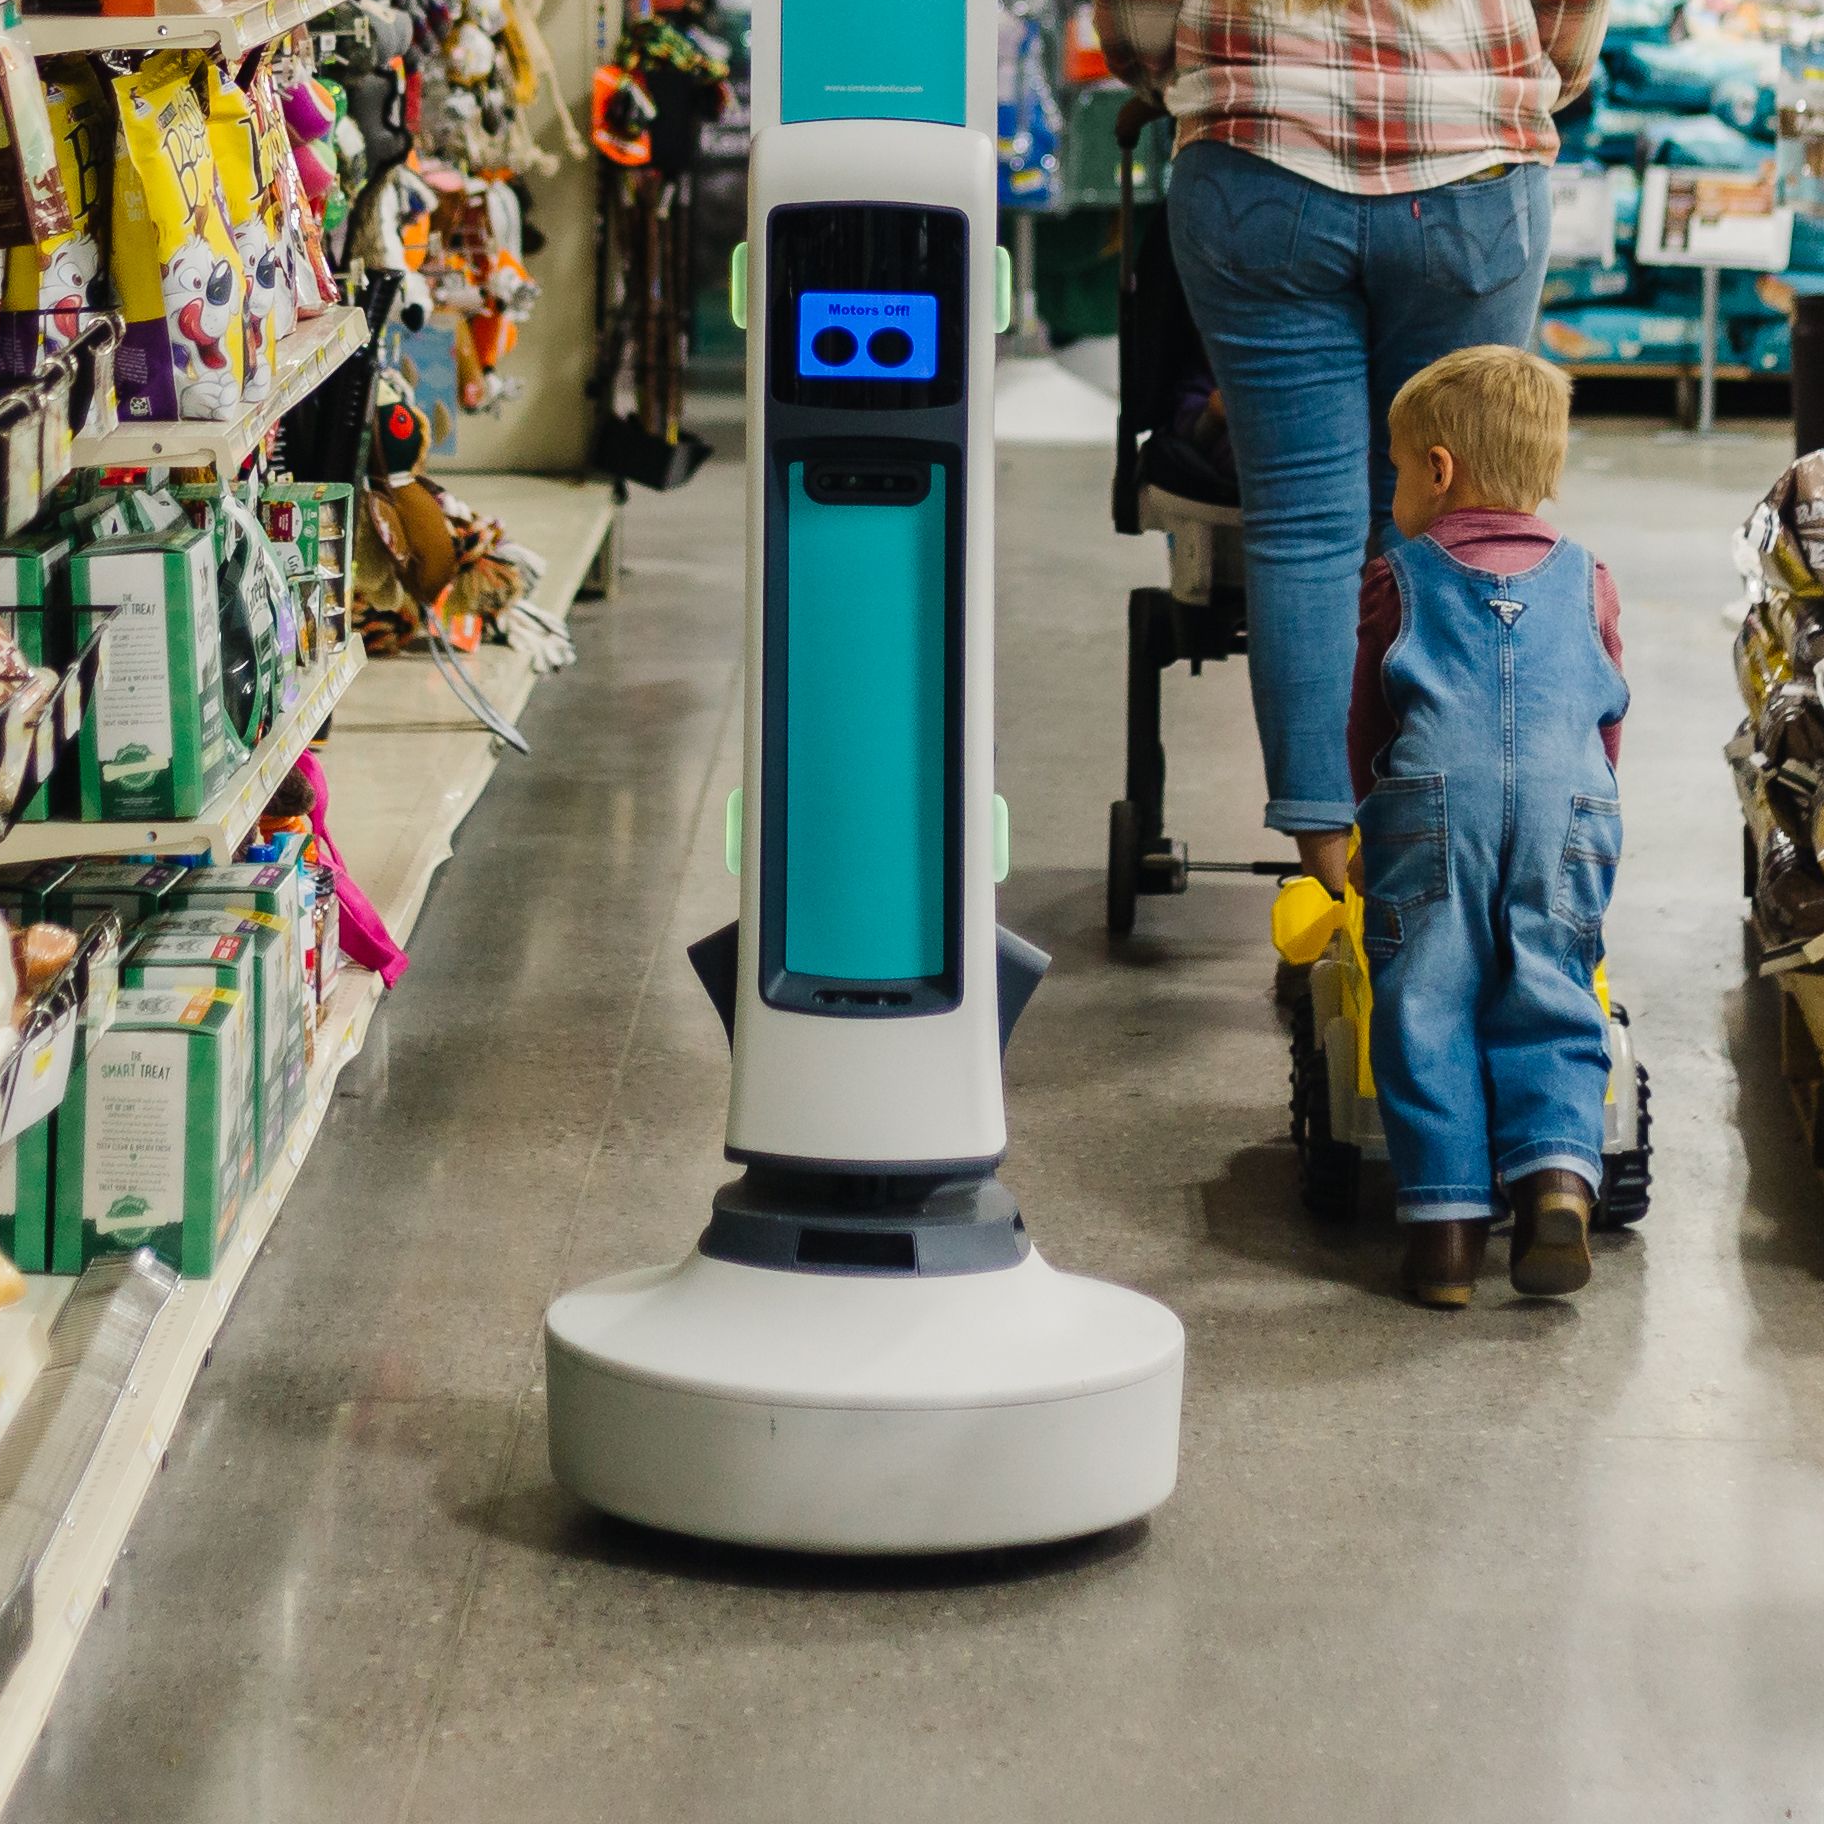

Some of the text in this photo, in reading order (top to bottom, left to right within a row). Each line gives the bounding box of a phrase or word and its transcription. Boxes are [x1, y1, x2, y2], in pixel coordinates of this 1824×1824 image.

[828, 303, 910, 317] Motors Off!
[100, 1062, 172, 1081] SMART TREAT
